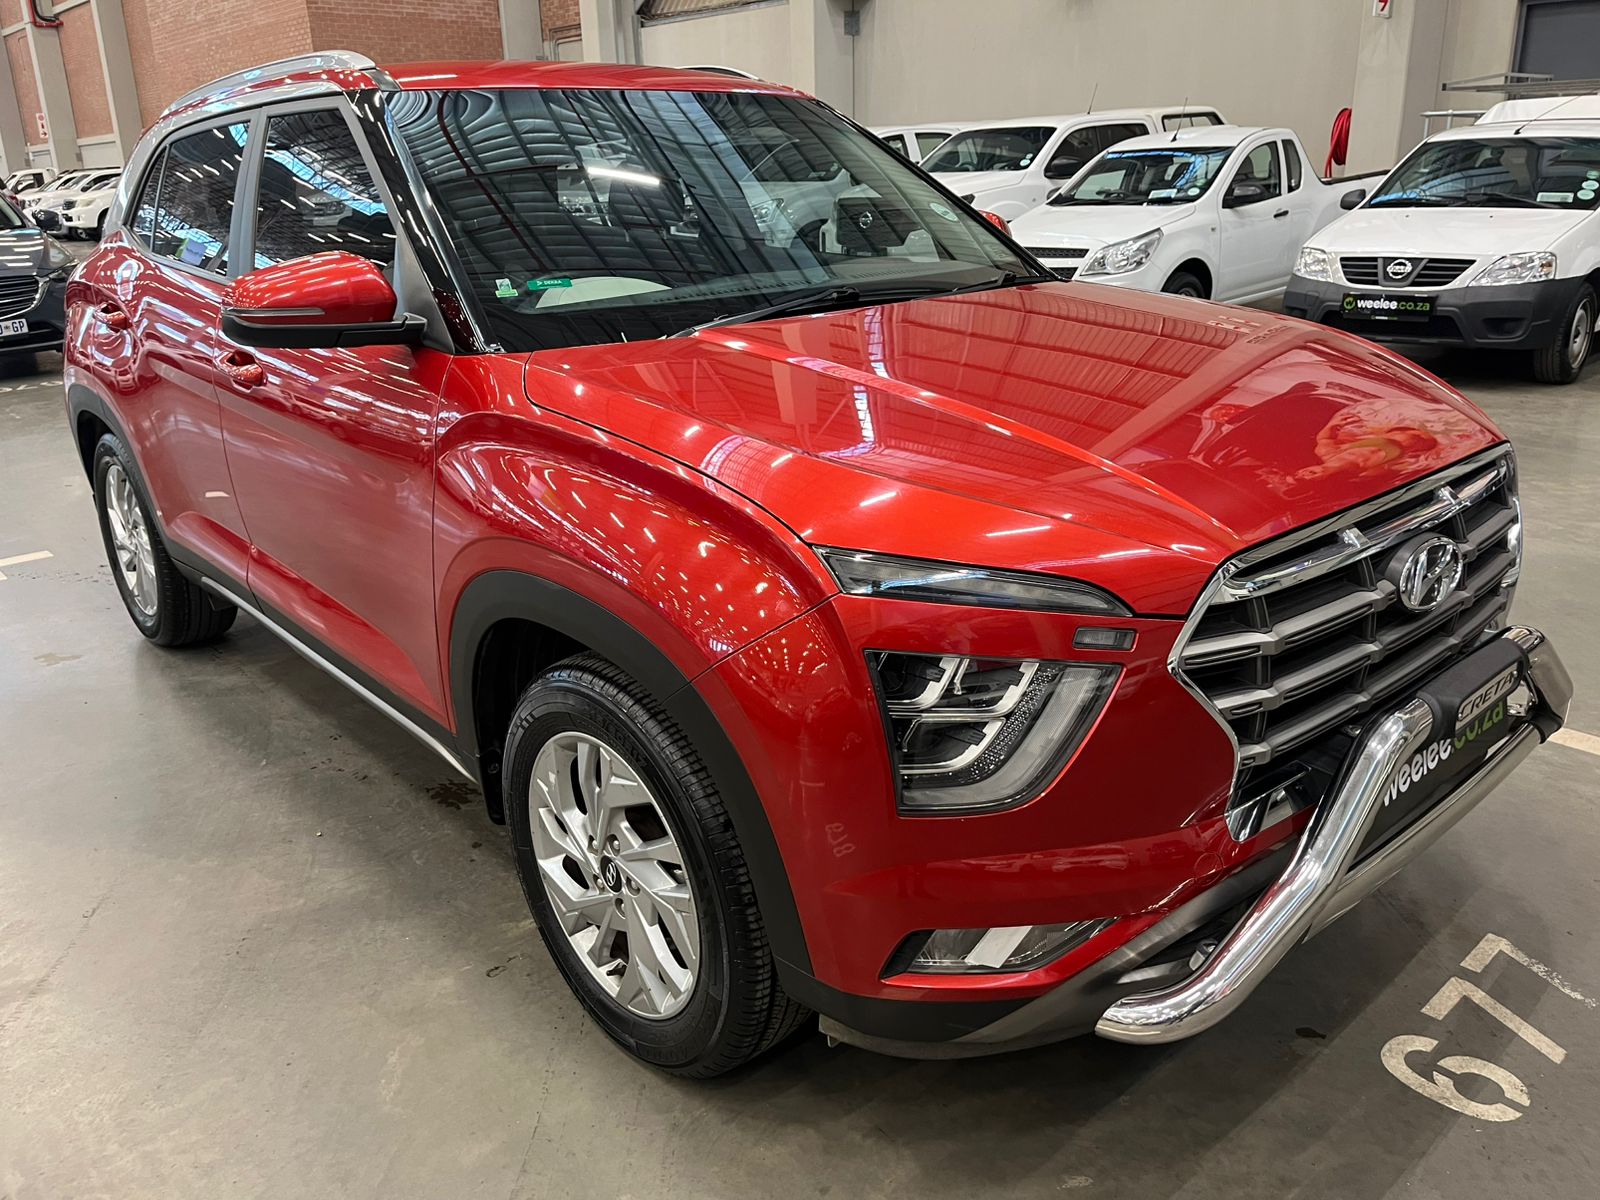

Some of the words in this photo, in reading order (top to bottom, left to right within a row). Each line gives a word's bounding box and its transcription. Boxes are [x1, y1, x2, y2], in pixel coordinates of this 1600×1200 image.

[1357, 299, 1430, 311] weelee.co.za
[11, 320, 25, 332] GP
[1461, 673, 1513, 717] CRETA
